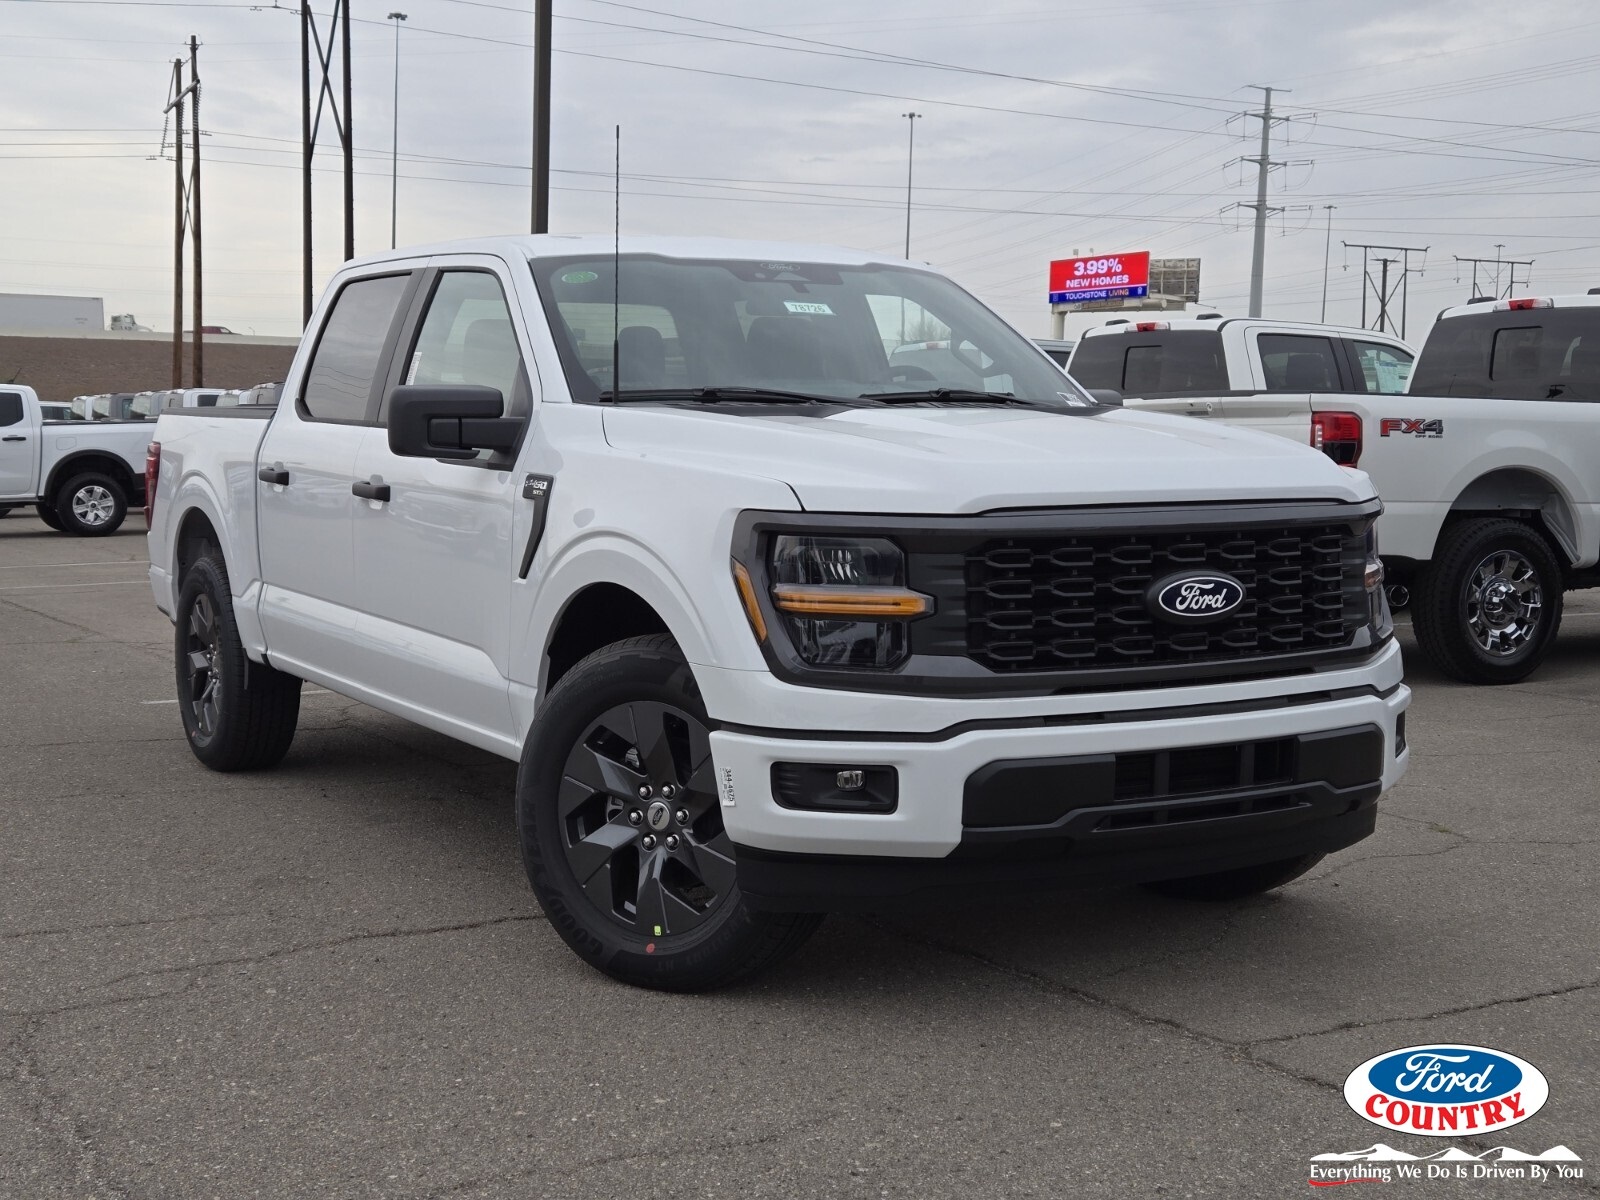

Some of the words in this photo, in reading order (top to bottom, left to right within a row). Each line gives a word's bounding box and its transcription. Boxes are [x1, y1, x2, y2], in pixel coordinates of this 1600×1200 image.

[1074, 258, 1122, 275] 3.99%
[1066, 278, 1091, 288] NEW
[1091, 275, 1129, 286] HOMES
[1065, 290, 1107, 300] TOUCHSTONE
[1108, 289, 1129, 297] LIVING
[1380, 418, 1443, 437] FX4
[1175, 583, 1228, 610] Ford
